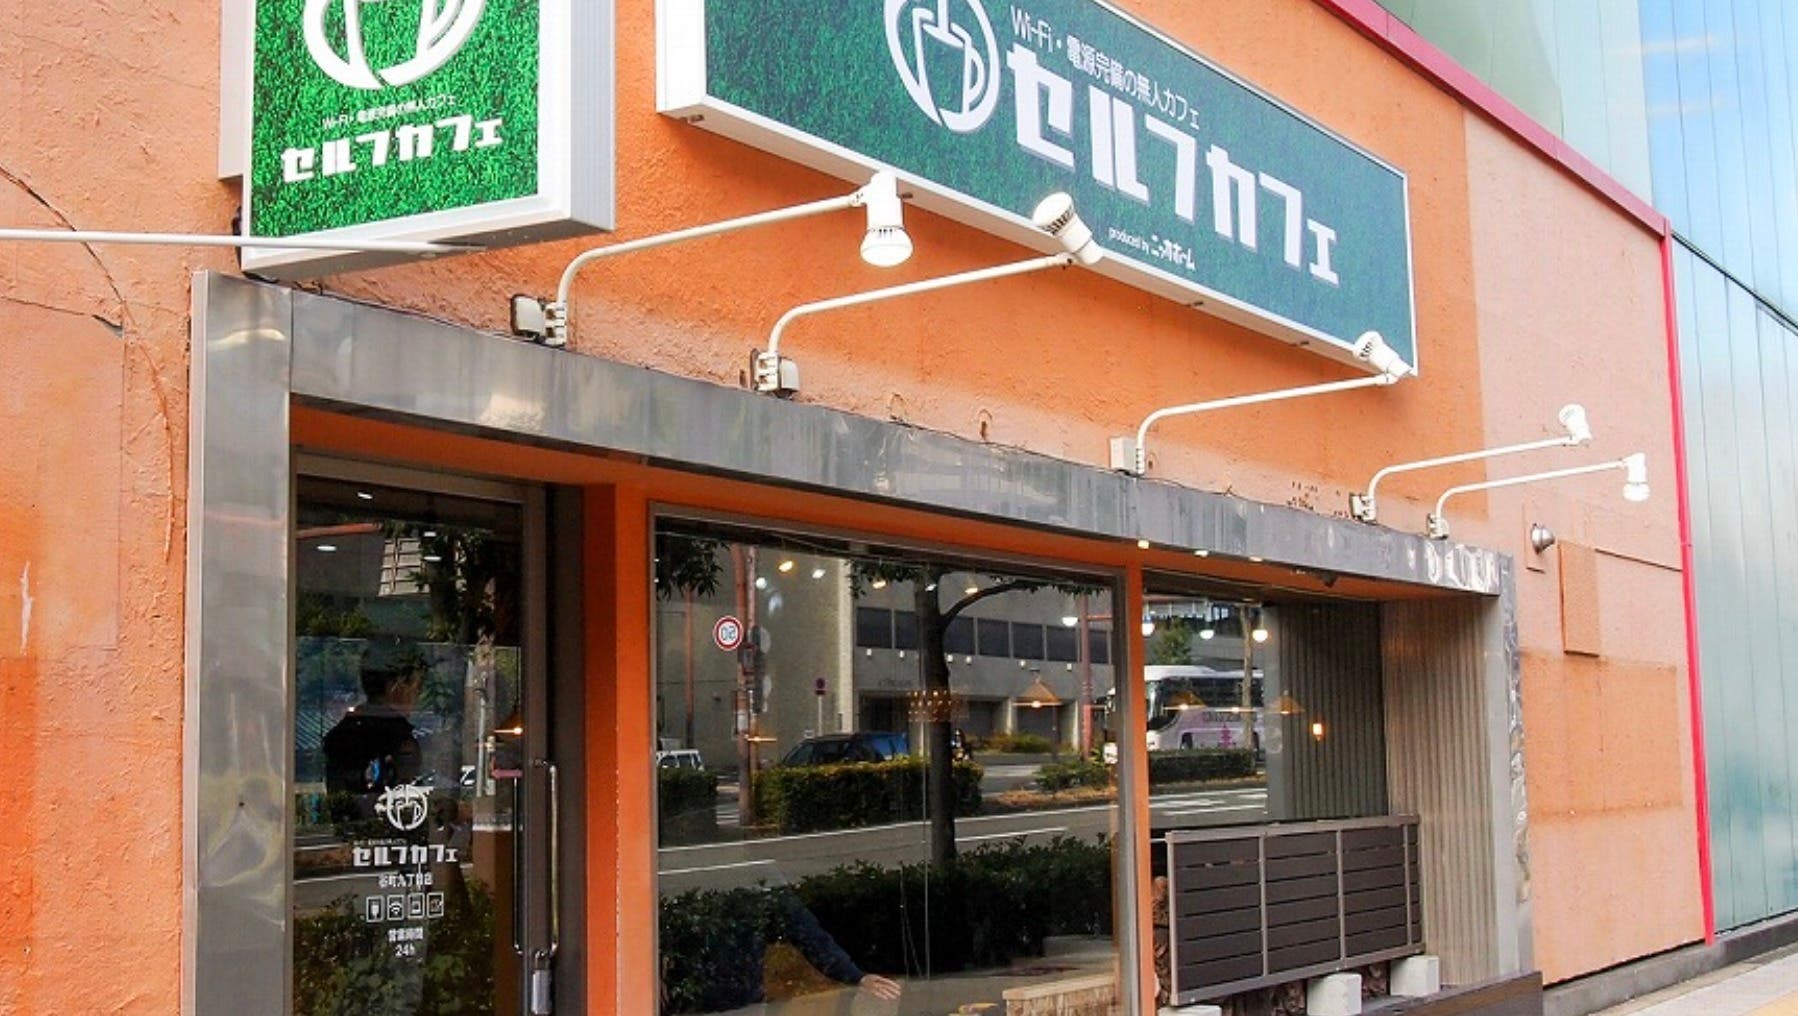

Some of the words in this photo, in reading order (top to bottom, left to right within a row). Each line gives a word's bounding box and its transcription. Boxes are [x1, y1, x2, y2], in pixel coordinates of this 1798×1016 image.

[281, 114, 502, 183] セルフカフェ
[1006, 42, 1339, 285] セルフカフェ
[352, 844, 458, 866] セルフカフェ
